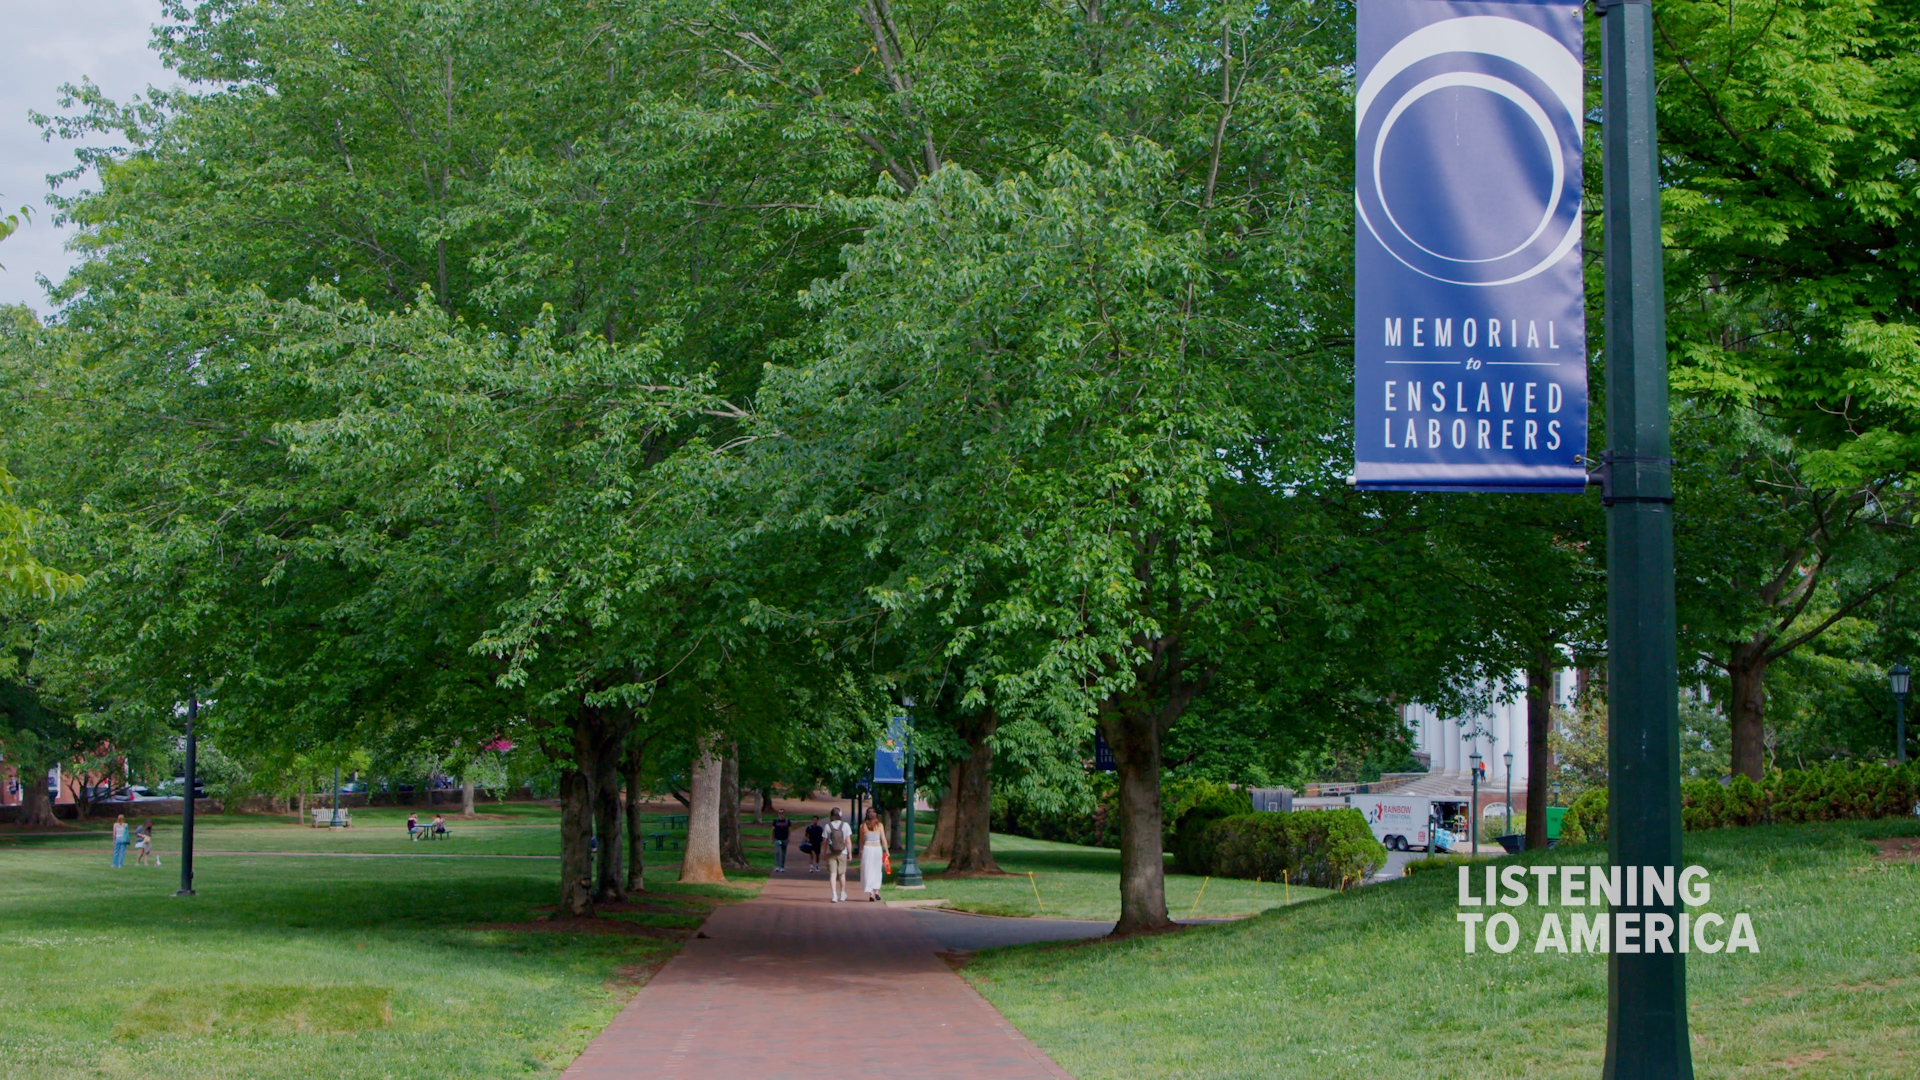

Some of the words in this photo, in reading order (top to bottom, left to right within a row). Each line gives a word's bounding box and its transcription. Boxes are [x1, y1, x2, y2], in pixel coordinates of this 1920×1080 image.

[1384, 317, 1560, 349] MEMORIAL
[1466, 357, 1481, 370] to
[1385, 381, 1562, 413] ENSLAVED
[1385, 418, 1561, 451] LABORERS
[1384, 805, 1411, 814] RAINBOW
